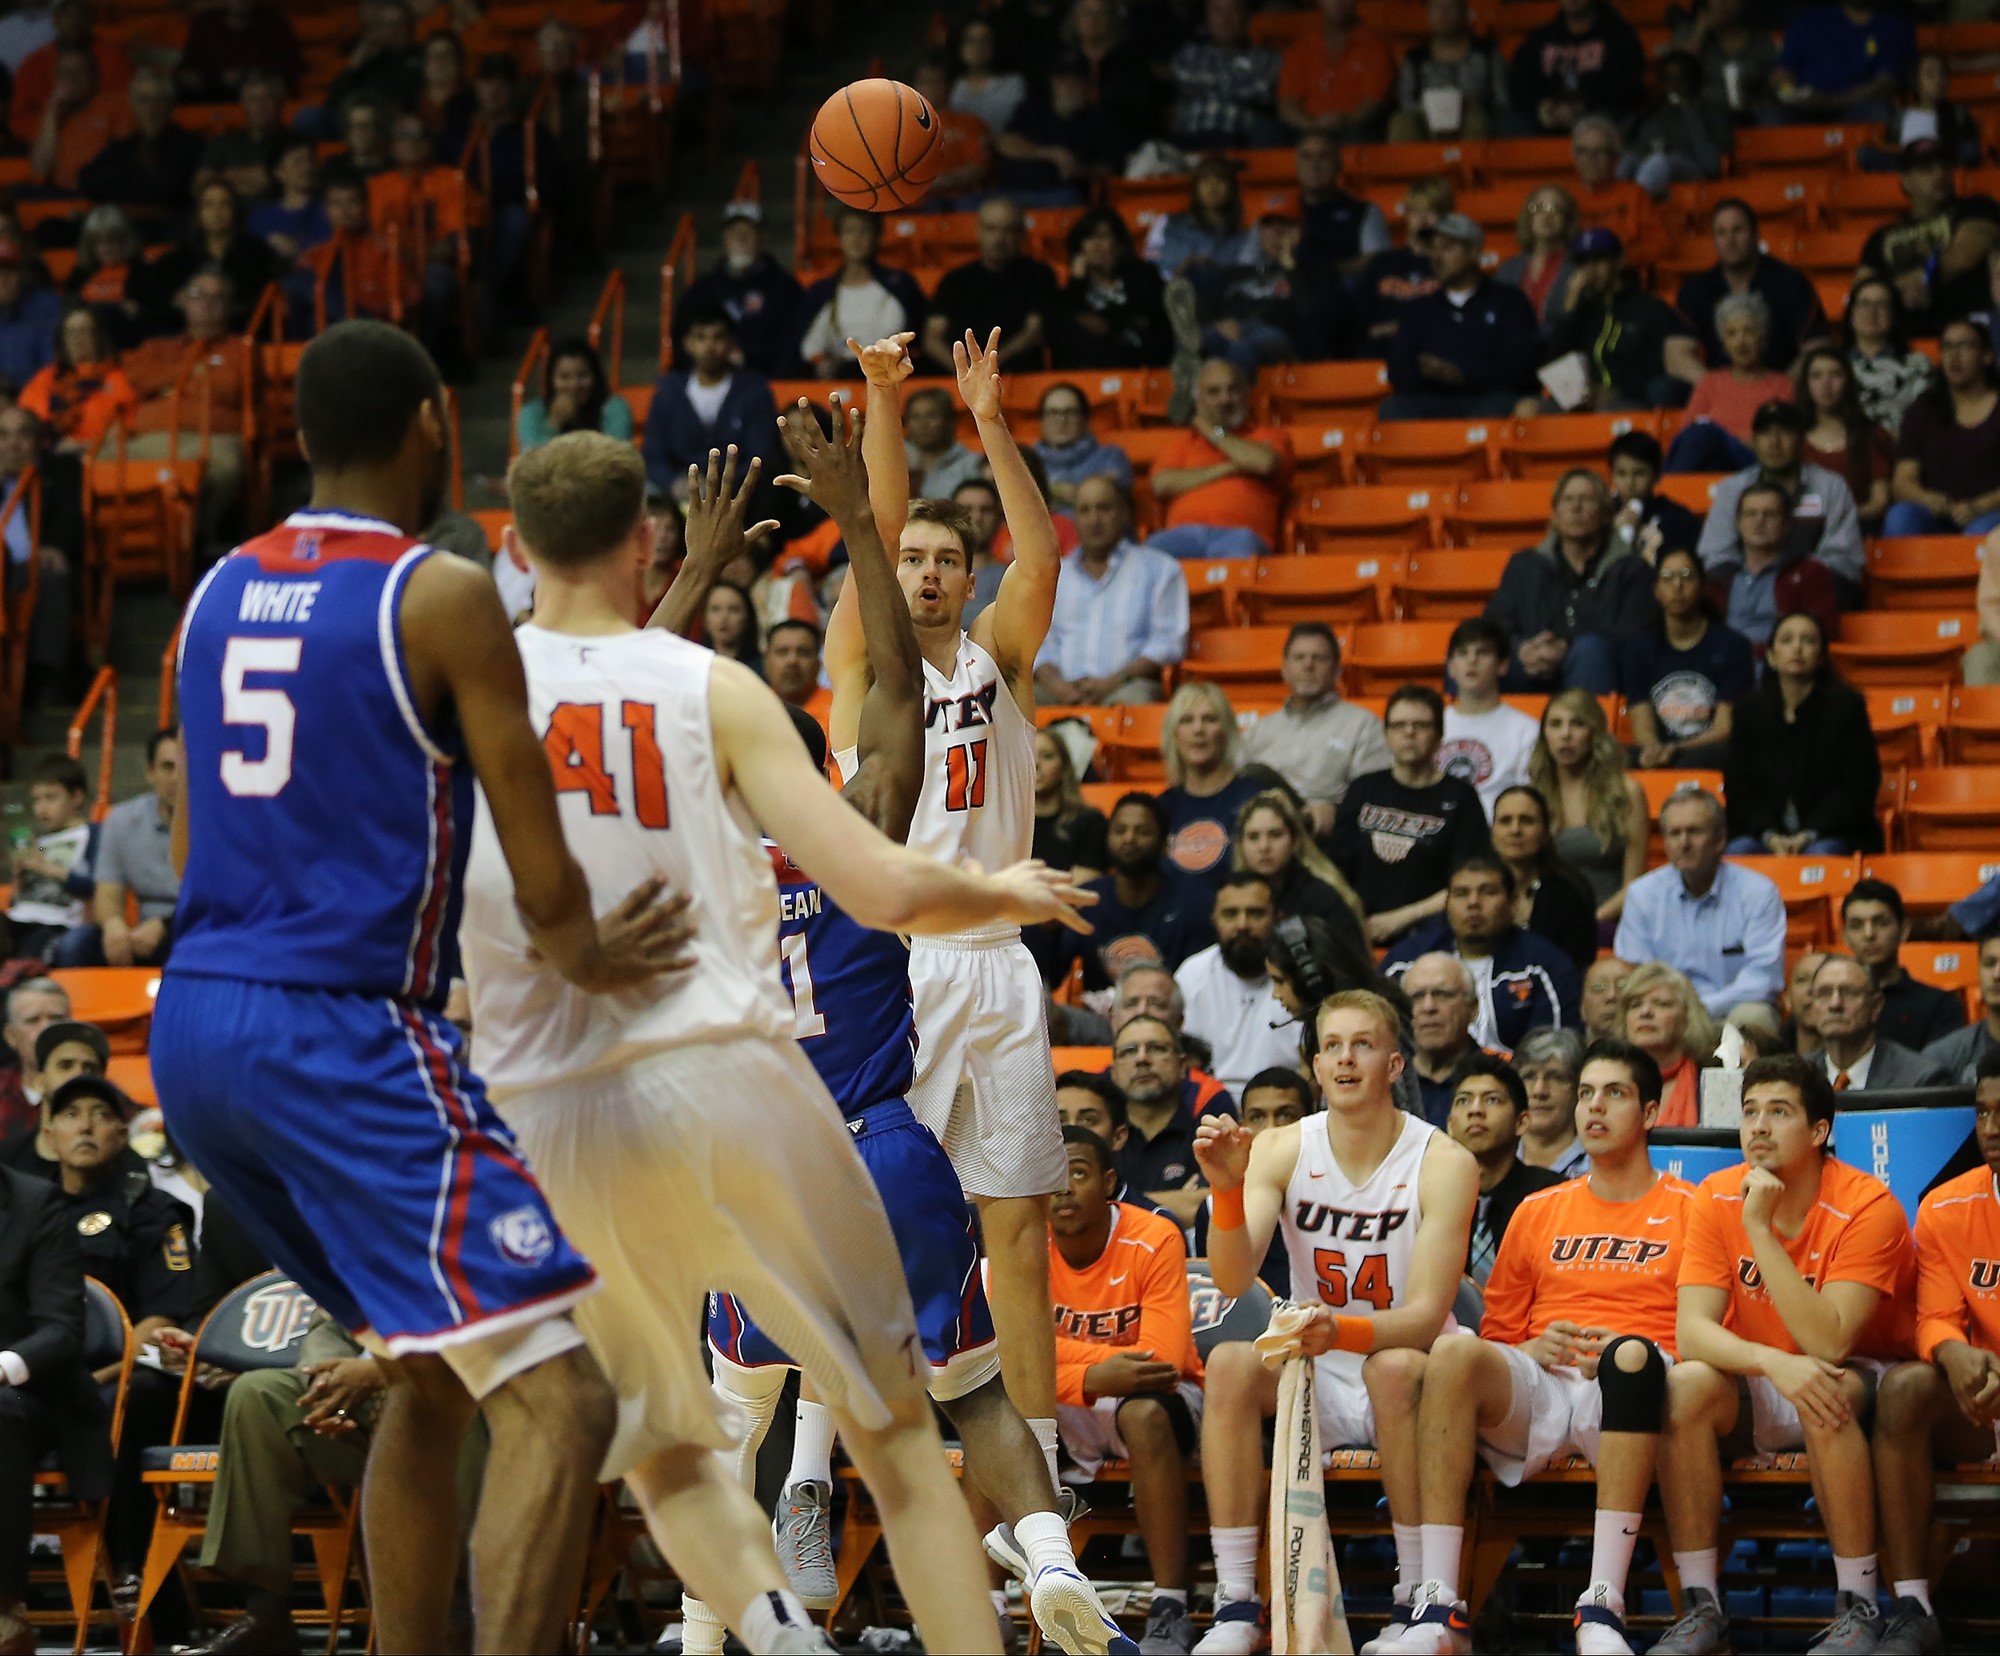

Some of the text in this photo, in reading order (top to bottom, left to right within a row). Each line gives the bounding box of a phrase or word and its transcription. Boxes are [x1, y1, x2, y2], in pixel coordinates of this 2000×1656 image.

[238, 579, 322, 623] WHITE
[220, 636, 303, 797] 5
[543, 699, 671, 831] 41
[945, 738, 988, 813] 11
[778, 887, 823, 921] EAN
[780, 931, 827, 1040] 1
[1296, 1199, 1410, 1242] UTEP
[1550, 1233, 1670, 1266] UTEP
[1313, 1247, 1394, 1311] 54
[1287, 1526, 1304, 1626] POWER
